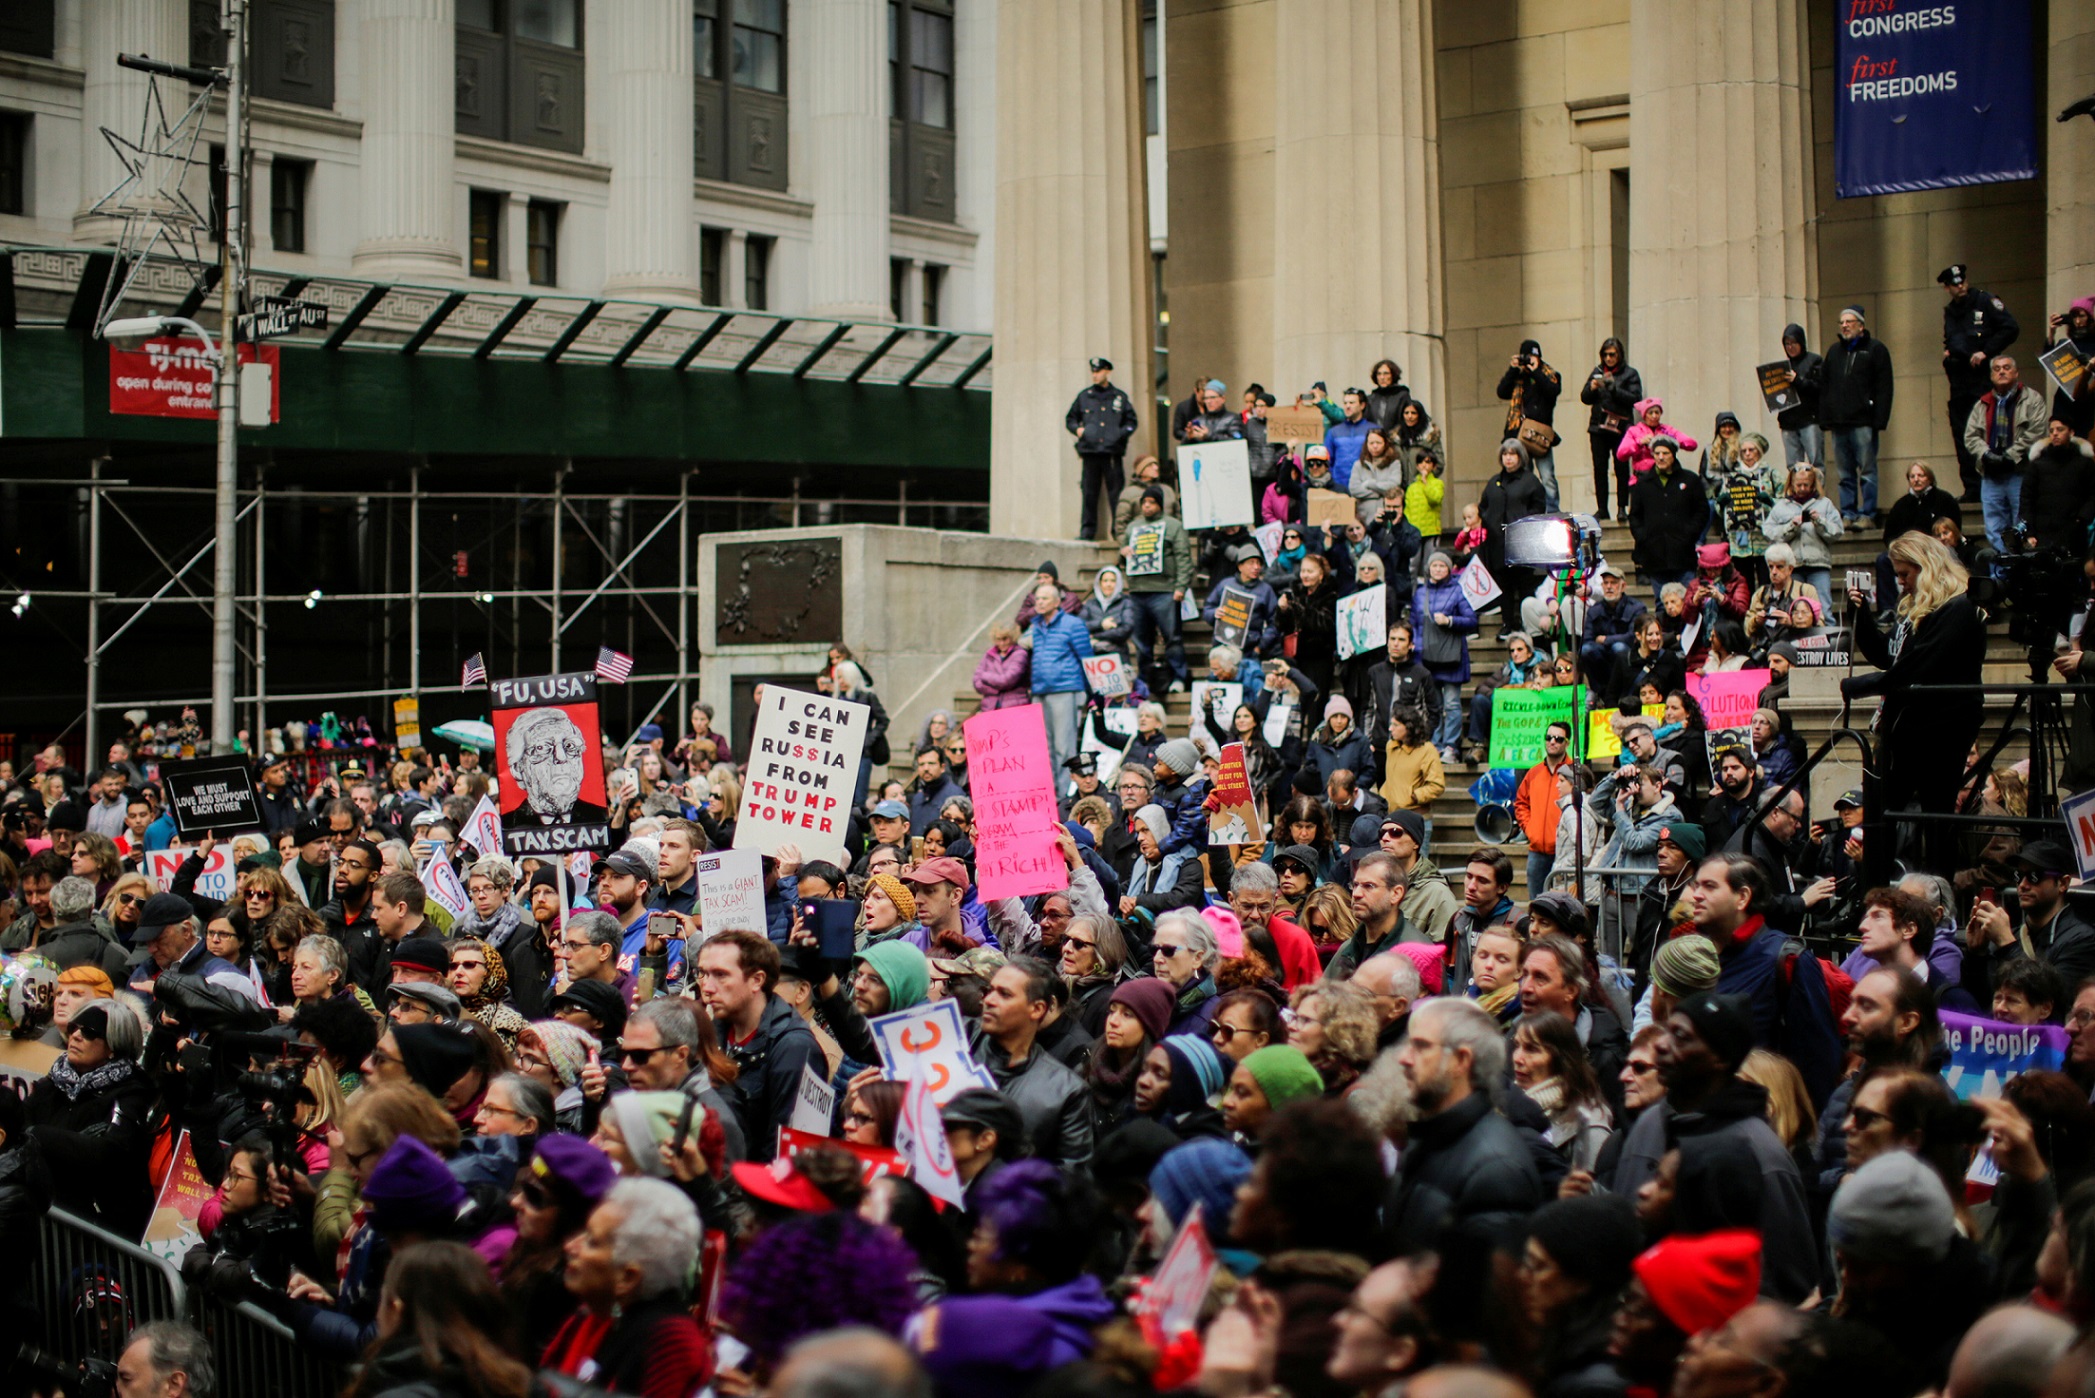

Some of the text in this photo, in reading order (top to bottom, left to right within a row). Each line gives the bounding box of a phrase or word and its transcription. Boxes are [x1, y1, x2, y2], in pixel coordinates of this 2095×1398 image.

[1850, 6, 1956, 38] CONGRESS
[1846, 55, 1898, 88] first
[1850, 71, 1957, 102] FREEDOMS
[257, 312, 298, 336] WALL ST
[117, 377, 149, 391] open
[152, 377, 193, 395] during
[1084, 659, 1116, 675] NO
[1796, 652, 1849, 665] ESTROY LIVES
[1106, 674, 1121, 684] TO
[778, 696, 850, 726] I CAN
[788, 720, 834, 744] SEE
[762, 737, 845, 769] RU$$IA
[983, 754, 1025, 774] PLAN
[767, 763, 829, 789] FROM
[1228, 782, 1245, 790] STREET
[176, 790, 250, 808] LOVE AND SUPPORT
[193, 783, 228, 796] WE MUST
[752, 781, 837, 811] TRUMP
[191, 802, 241, 815] EACH OTHER
[748, 803, 832, 833] TOWER
[991, 794, 1044, 818] STAMP
[508, 826, 610, 852] TAX SCAM
[700, 858, 720, 871] RESIST
[202, 873, 226, 890] TO
[702, 883, 718, 895] This
[734, 875, 759, 891] GIANT
[430, 889, 457, 913] RESIST
[704, 891, 748, 910] TAX SCAM!
[22, 978, 54, 1004] Get
[1971, 1025, 2041, 1062] People
[803, 1077, 834, 1118] DESTROY
[183, 1171, 201, 1184] TAX
[177, 1184, 200, 1198] WALL
